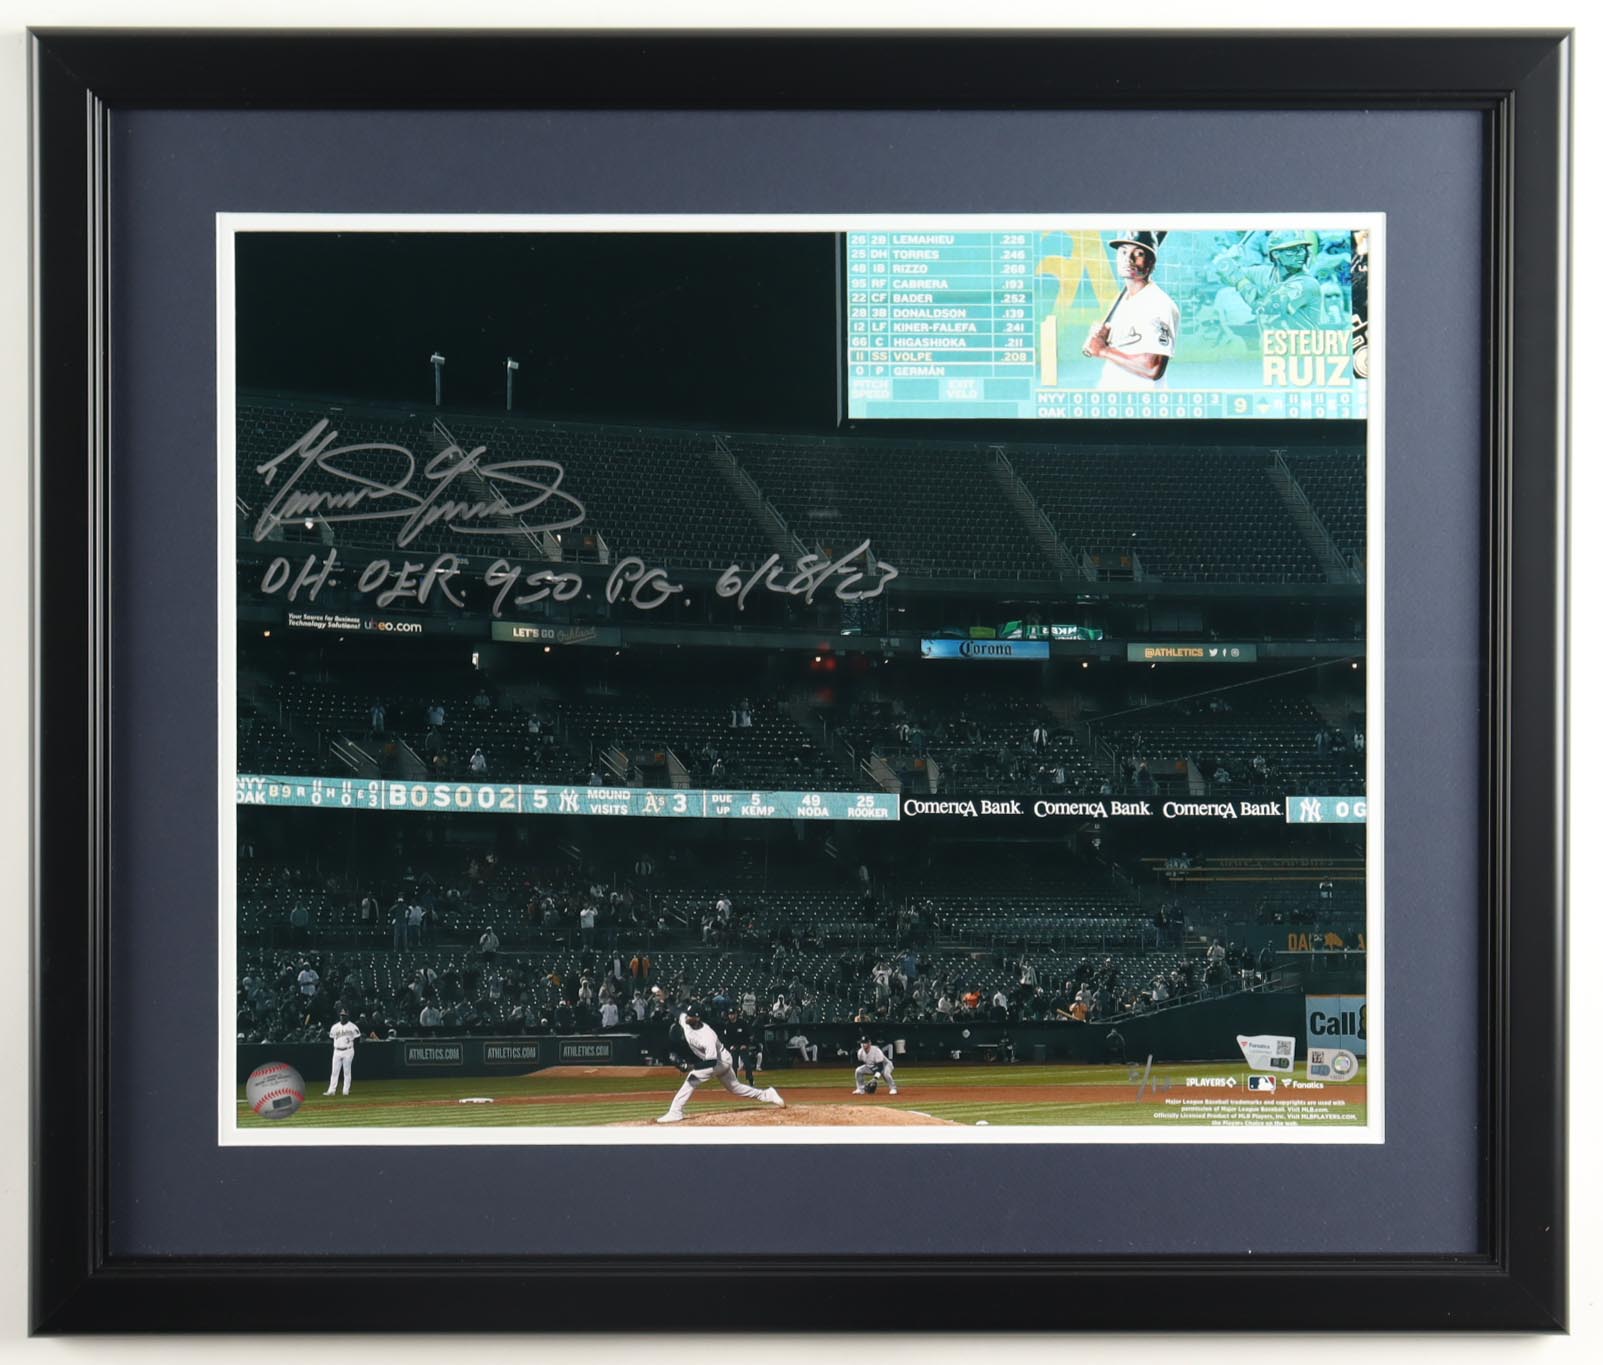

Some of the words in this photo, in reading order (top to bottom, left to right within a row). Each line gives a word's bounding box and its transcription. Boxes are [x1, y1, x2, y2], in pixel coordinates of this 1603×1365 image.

[893, 235, 954, 245] LEMAHIEU
[871, 249, 887, 259] DH
[893, 249, 939, 259] TORRES
[893, 264, 928, 274] RIZZO
[871, 279, 887, 289] RF
[893, 279, 948, 289] CABRERA
[851, 294, 866, 303] 22
[871, 294, 887, 303] CF
[893, 294, 933, 303] BADER
[893, 308, 967, 318] DONALDSON
[871, 323, 887, 332] LF
[893, 323, 976, 332] KINER-FALEFA
[875, 337, 883, 347] C
[893, 337, 966, 347] HIGASHIOKA
[1264, 330, 1351, 355] ESTEURY
[871, 352, 887, 361] SS
[893, 352, 933, 361] VOLPE
[876, 366, 884, 375] P
[1264, 356, 1351, 386] RUIZ
[1038, 393, 1065, 403] NYY
[1234, 398, 1248, 414] 9
[1038, 407, 1066, 417] OAK
[335, 615, 360, 623] Business
[288, 620, 326, 629] Technology
[328, 621, 361, 629] Solutions!
[364, 618, 422, 632] ubeo.com
[512, 627, 539, 638] LET'S
[541, 629, 555, 639] GO
[959, 640, 1012, 658] Corona
[1144, 648, 1204, 659] @ATHLETICS
[297, 787, 305, 797] R
[326, 788, 335, 798] H
[357, 789, 365, 799] E
[587, 790, 631, 800] MOUND
[368, 795, 378, 807] 3
[533, 789, 548, 809] 5
[672, 793, 688, 813] 3
[712, 795, 732, 803] DUE
[751, 794, 761, 806] 5
[802, 795, 821, 806] 49
[856, 796, 875, 807] 25
[590, 804, 628, 815] VISITS
[716, 807, 731, 815] UP
[741, 807, 775, 816] KEMP
[797, 807, 829, 817] NODA
[848, 807, 888, 818] ROOKER
[1310, 1011, 1356, 1036] Call
[409, 1048, 460, 1060] ATHLETICS.COM
[487, 1047, 536, 1059] ATHLETICS.COM
[563, 1045, 609, 1057] ATHLETICS.COM
